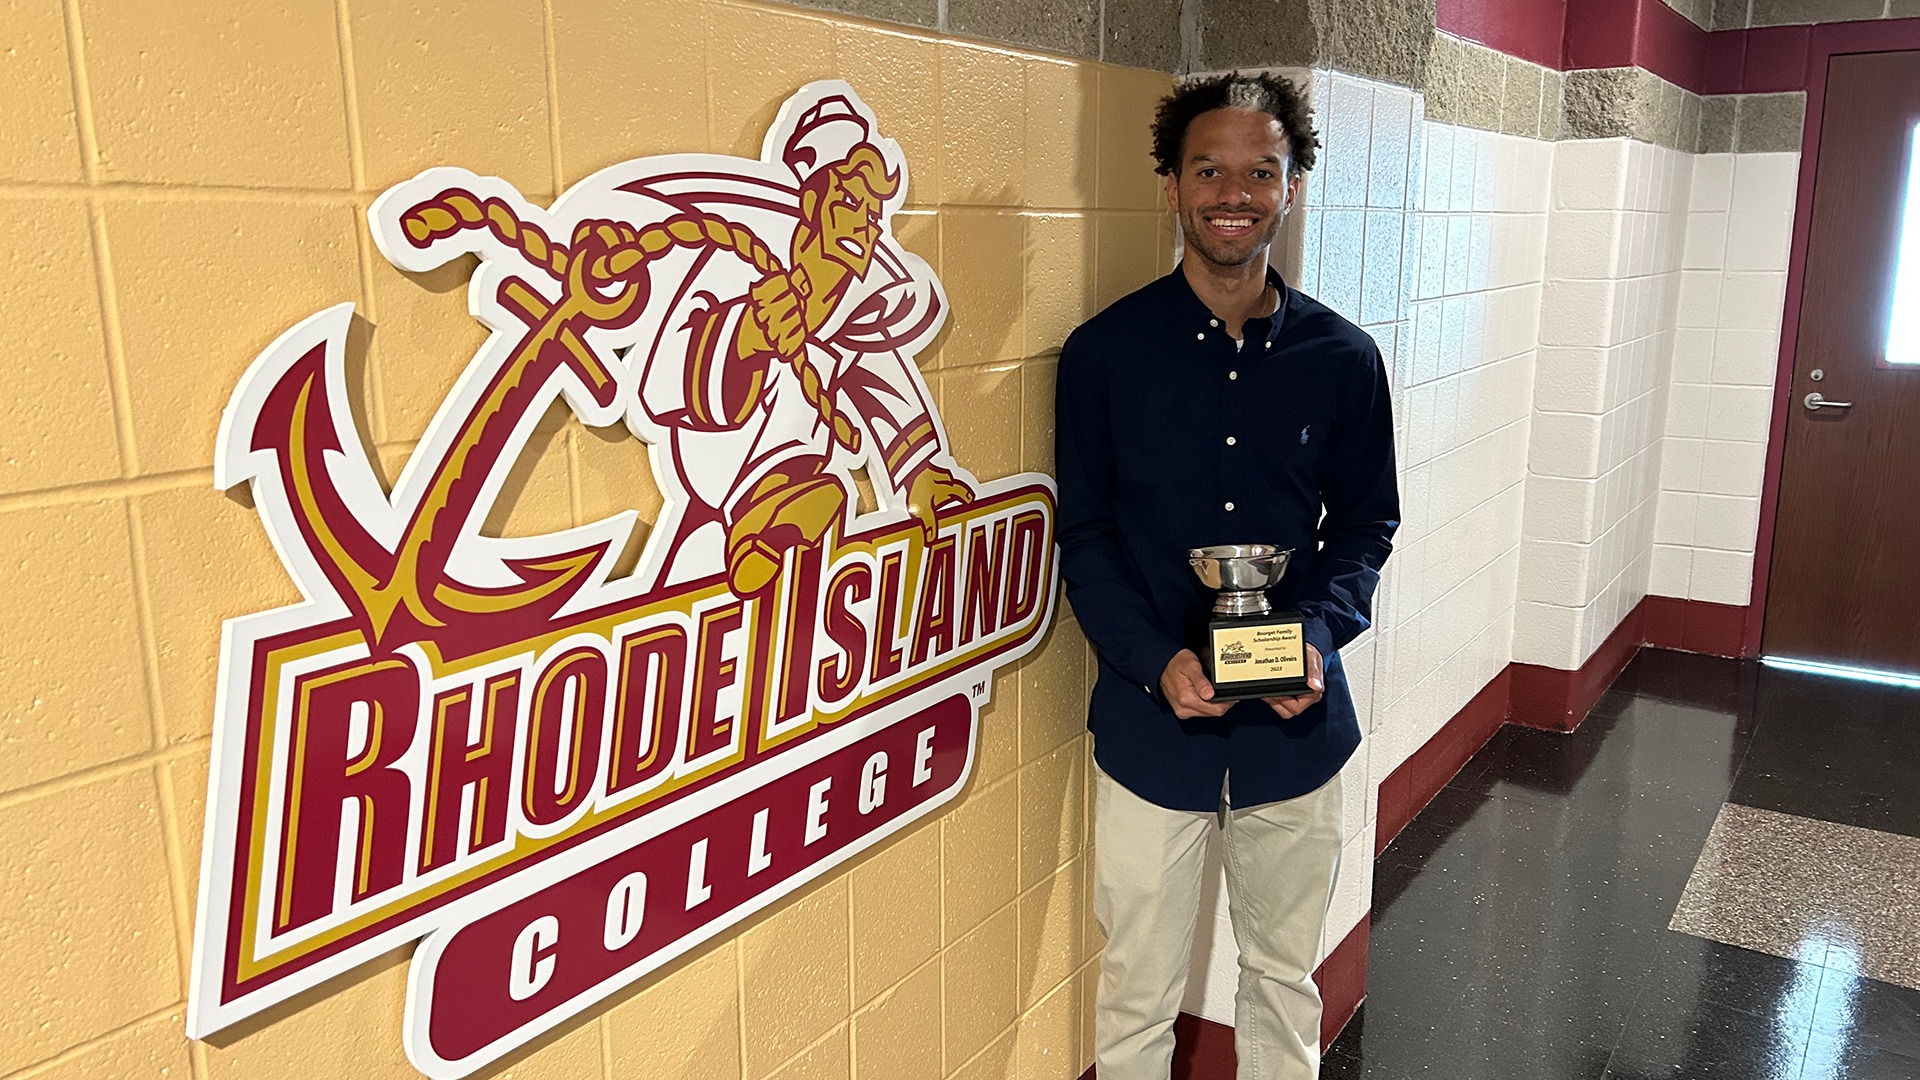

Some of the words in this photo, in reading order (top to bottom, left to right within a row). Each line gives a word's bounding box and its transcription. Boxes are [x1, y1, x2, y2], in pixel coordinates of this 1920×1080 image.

[271, 602, 744, 940] RHODE
[774, 509, 1044, 725] ISLAND
[971, 680, 986, 698] TM
[509, 724, 936, 1001] COLLEGE
